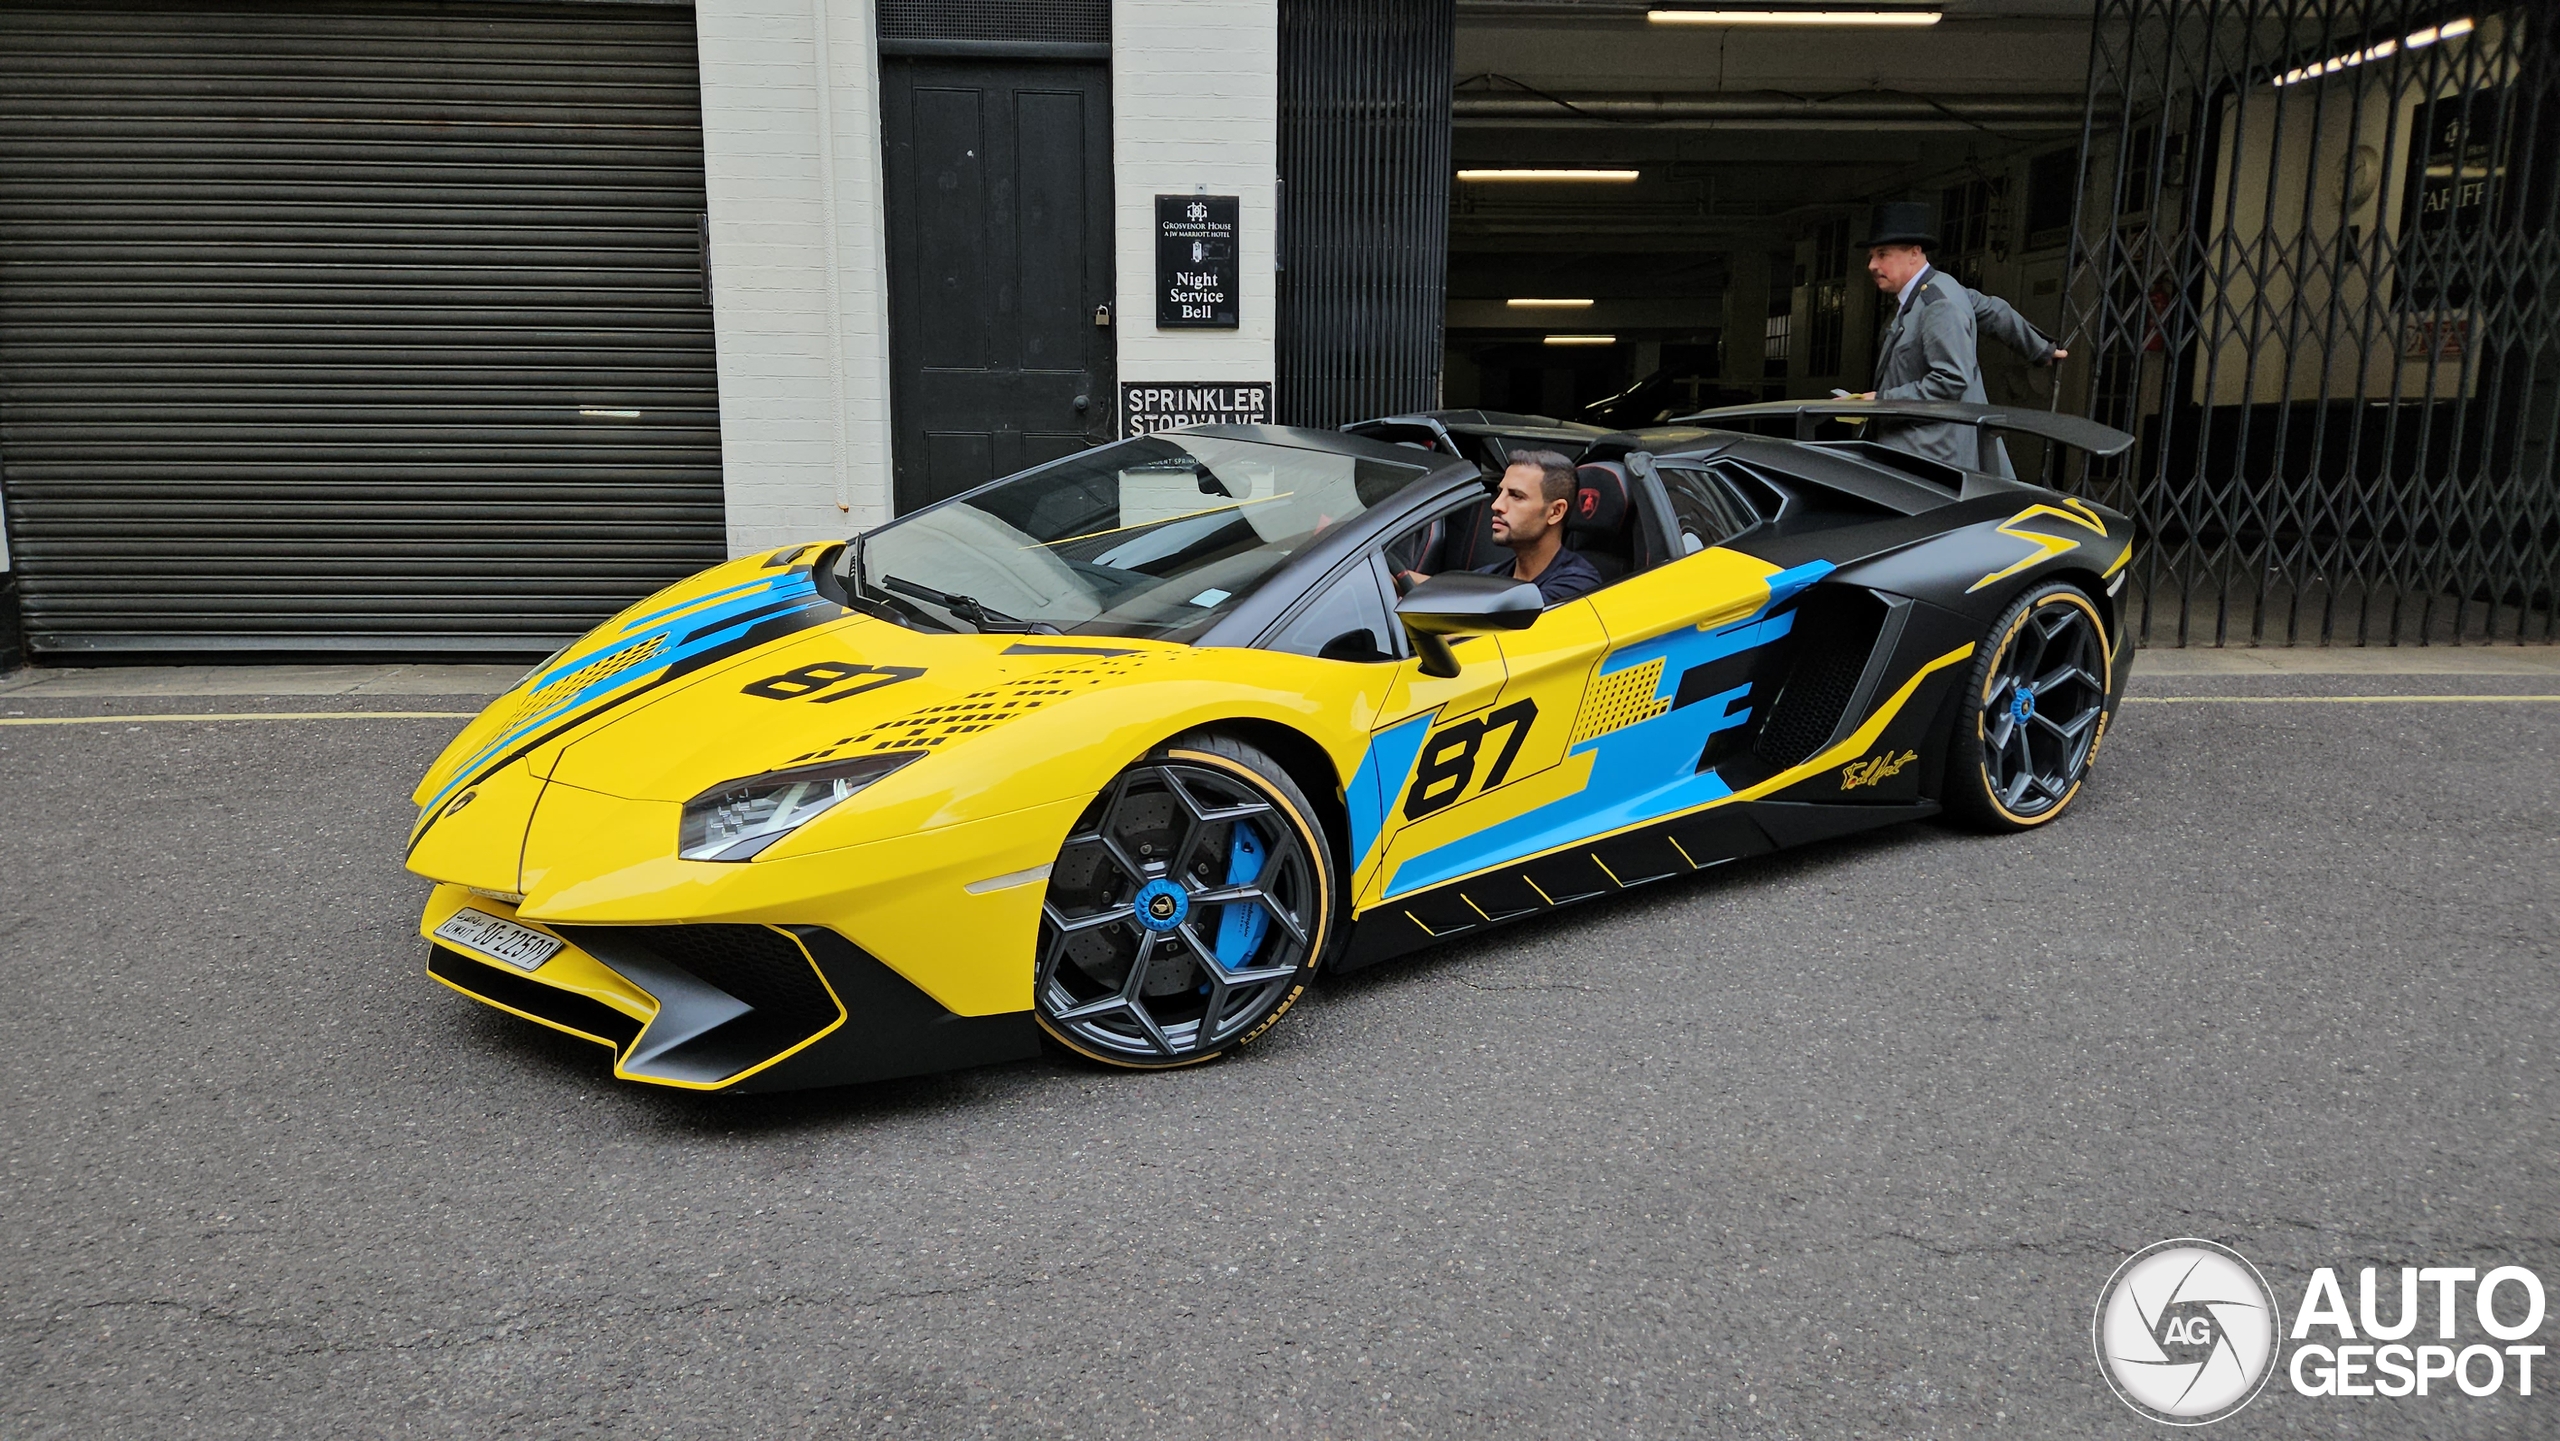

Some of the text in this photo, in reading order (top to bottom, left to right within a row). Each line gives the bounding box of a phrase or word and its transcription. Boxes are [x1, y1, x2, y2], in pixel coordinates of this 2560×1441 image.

[1208, 221, 1231, 230] HOUSE
[1176, 271, 1219, 289] Night
[1170, 288, 1224, 303] Service
[1182, 304, 1212, 319] Bell
[1128, 388, 1265, 412] SPRINKLER
[740, 661, 928, 704] 87
[1402, 697, 1540, 821] 87
[441, 922, 475, 939] KUWAIT
[1239, 984, 1305, 1046] PIRELLI
